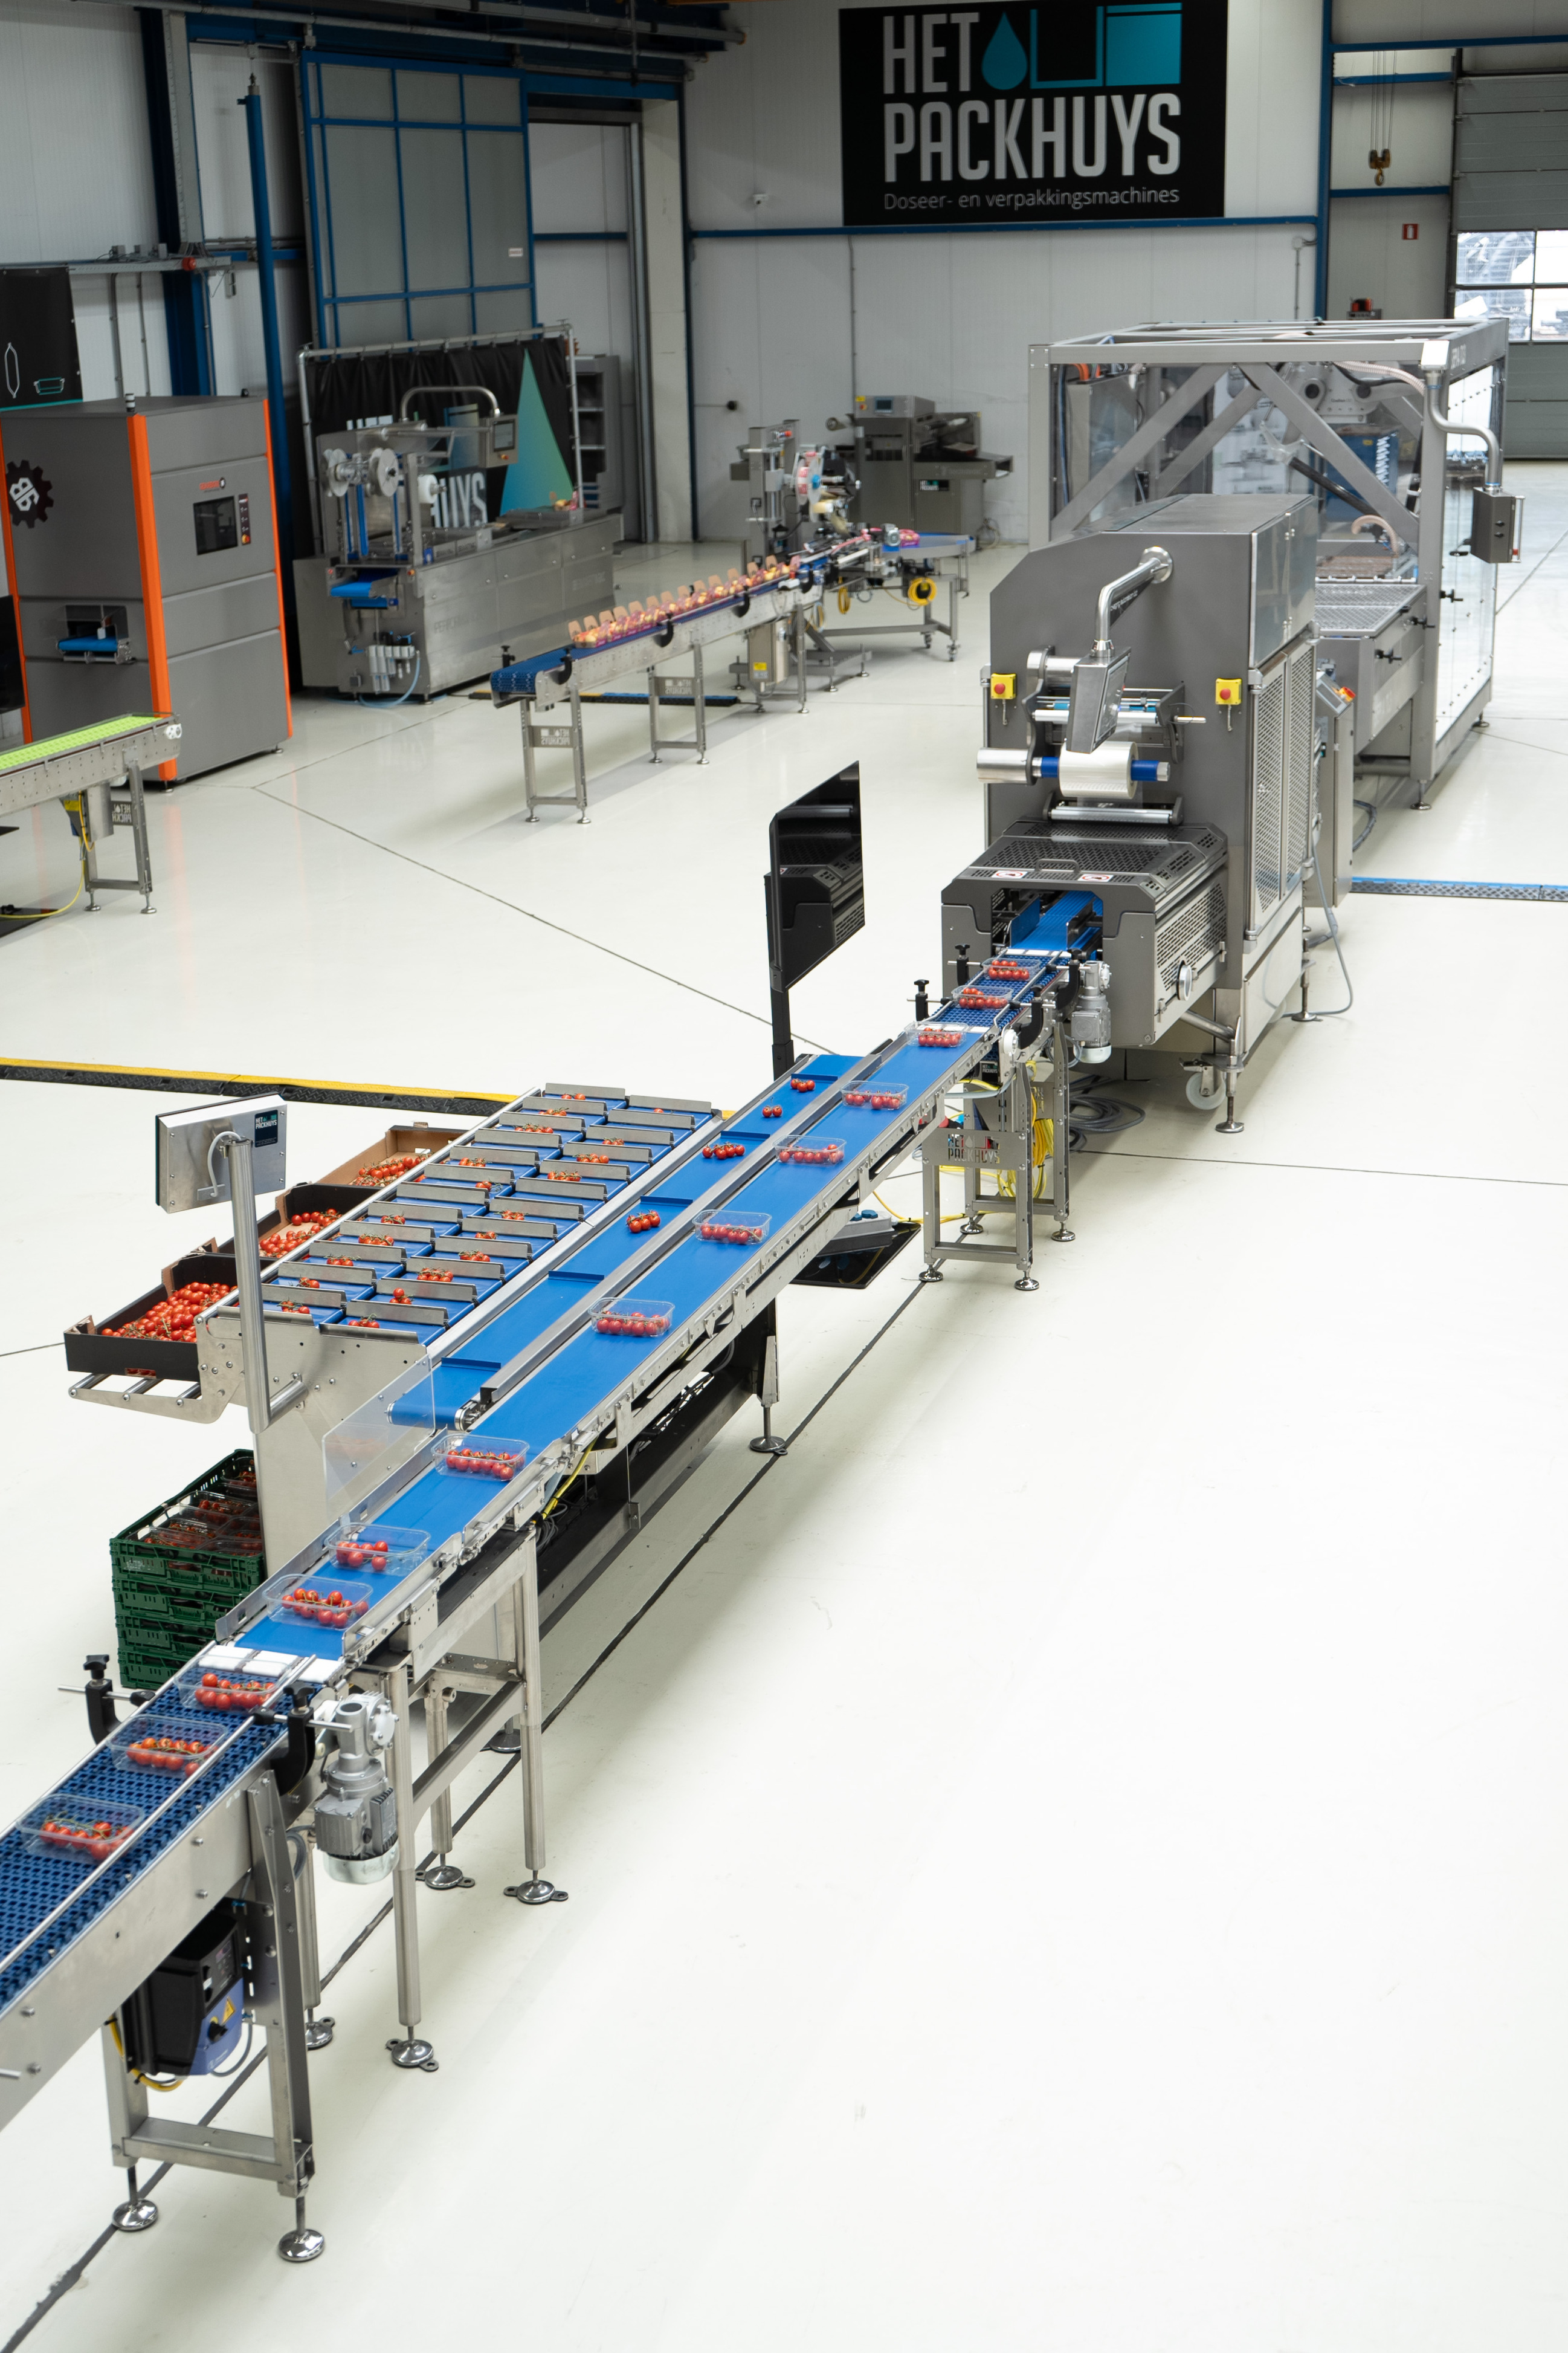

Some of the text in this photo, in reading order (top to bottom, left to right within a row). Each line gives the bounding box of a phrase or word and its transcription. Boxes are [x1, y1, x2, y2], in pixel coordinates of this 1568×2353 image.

[883, 12, 979, 94] HET
[884, 93, 1181, 182] PACKHUYS
[884, 186, 1179, 211] Doseer- en verpakkingsmachines
[256, 1119, 277, 1129] PACKHUYS
[948, 1134, 964, 1147] HET
[948, 1148, 1000, 1164] PACKHUYS
